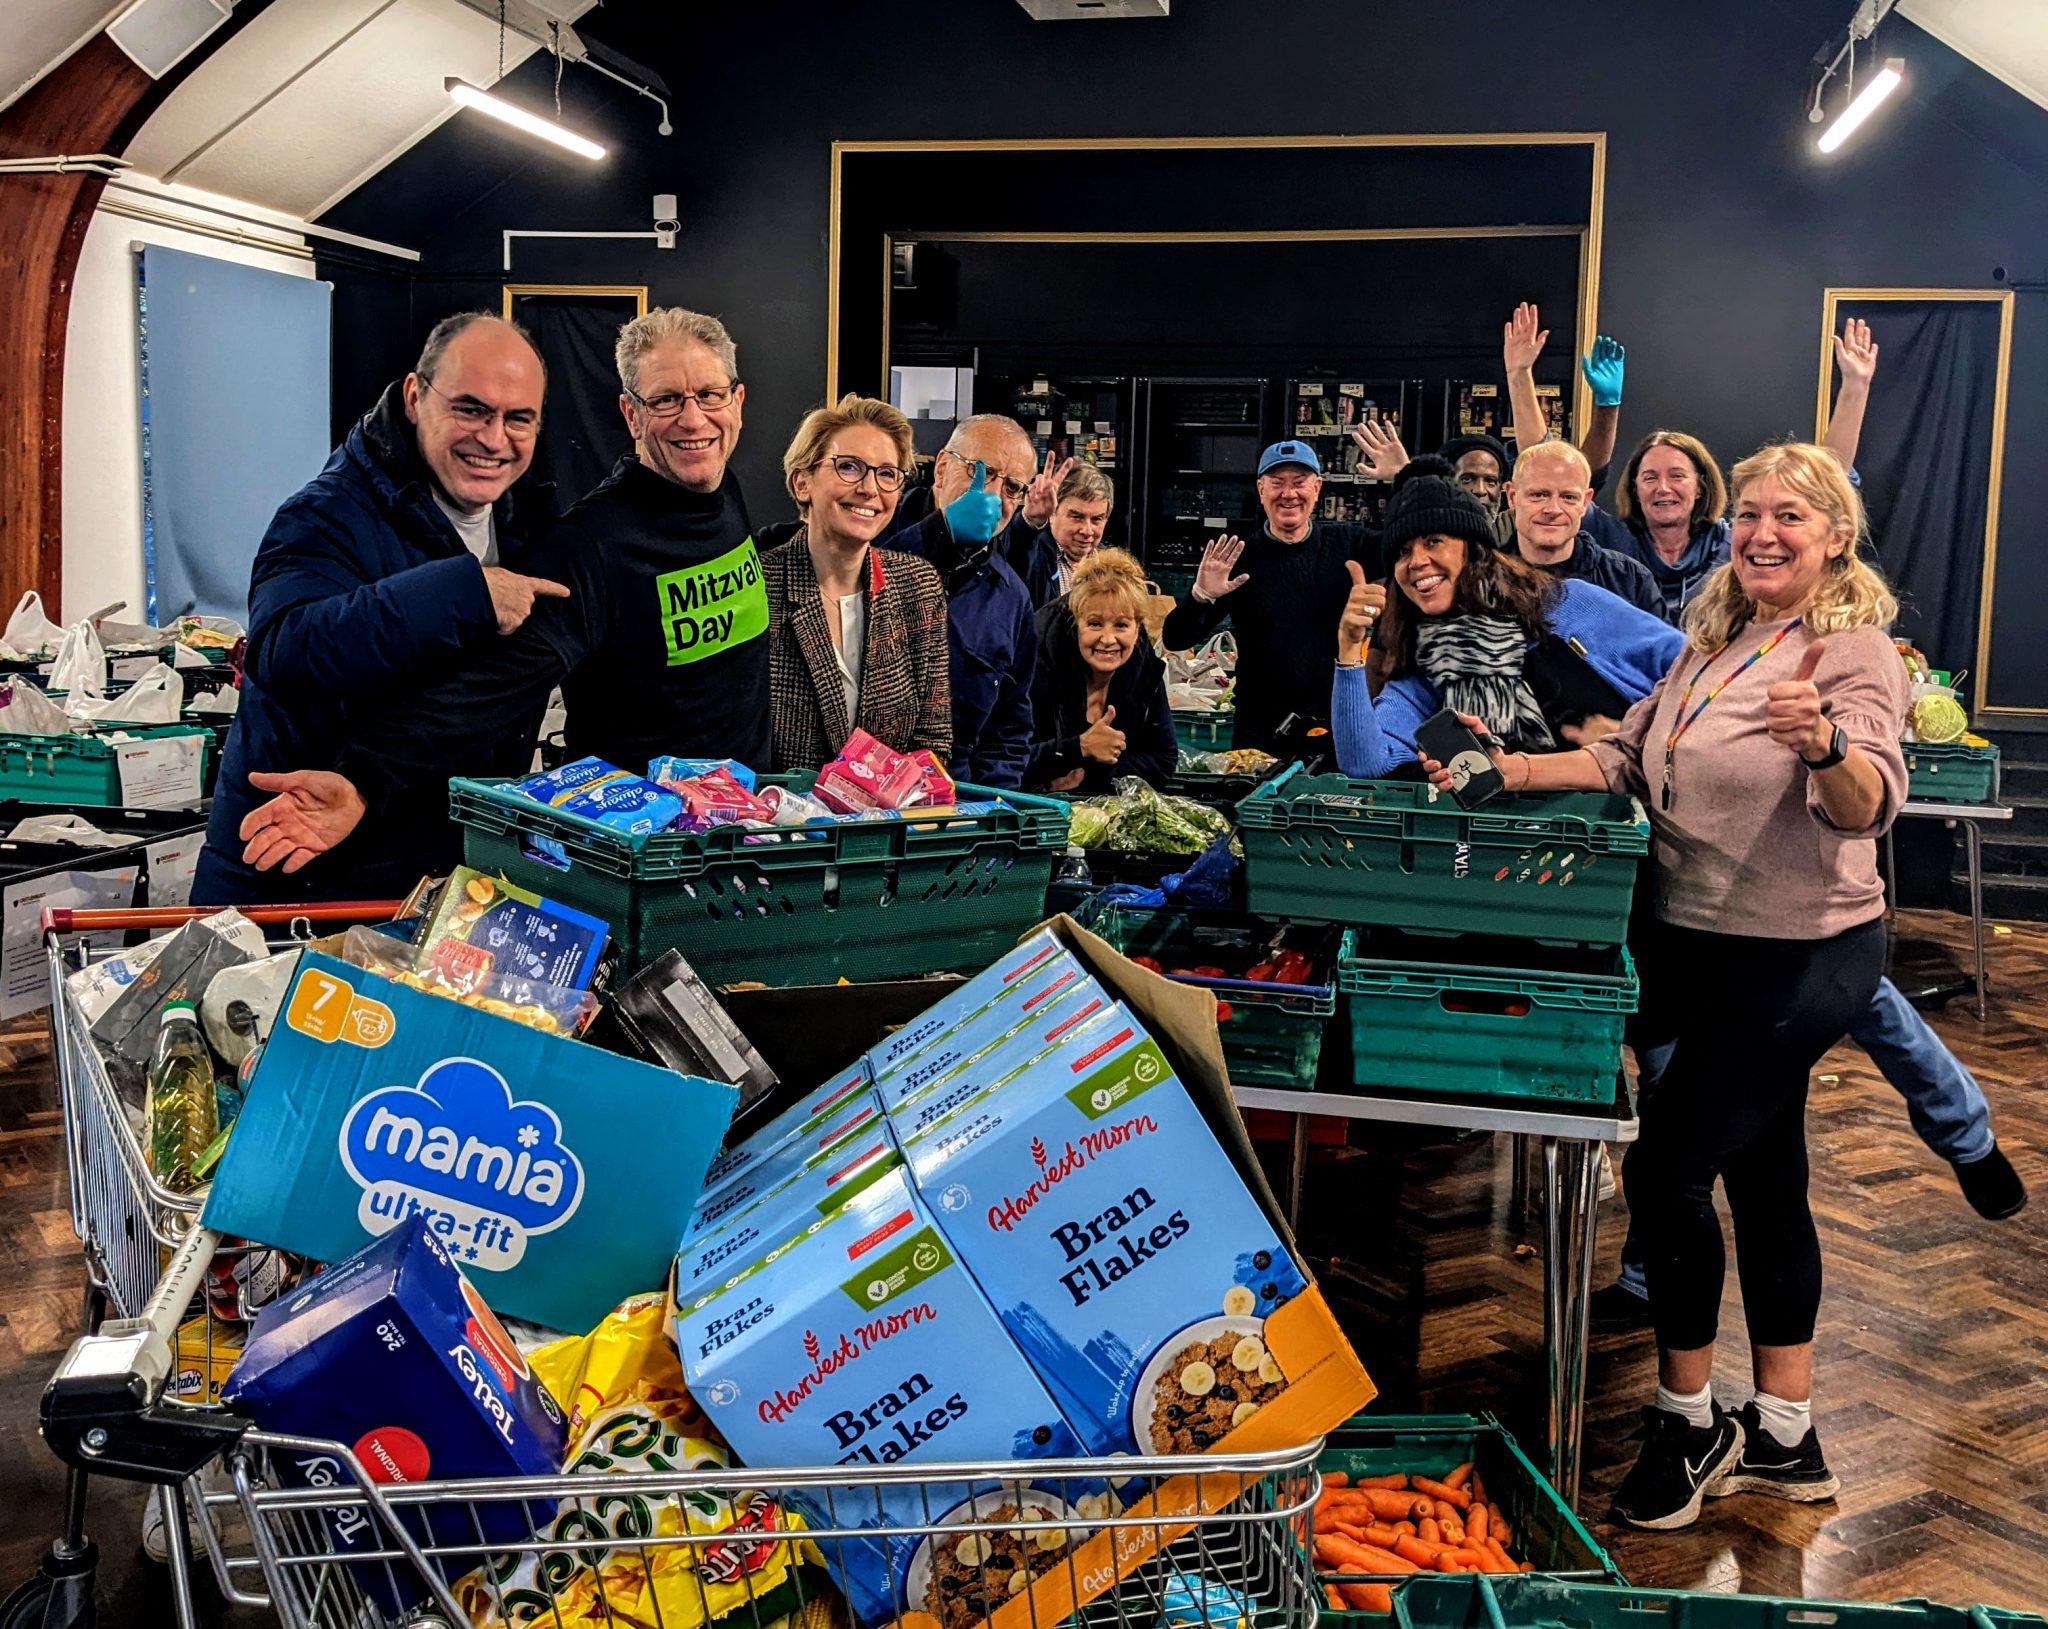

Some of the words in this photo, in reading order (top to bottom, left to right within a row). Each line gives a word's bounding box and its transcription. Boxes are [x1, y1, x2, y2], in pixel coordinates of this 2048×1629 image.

[667, 552, 763, 616] Mitzvah
[674, 610, 735, 651] Day
[552, 762, 601, 792] always
[593, 783, 644, 814] always
[313, 980, 337, 1011] 7
[362, 1023, 377, 1035] 22
[885, 1019, 945, 1062] Flakes
[890, 1018, 936, 1050] Bran
[898, 1050, 962, 1096] Flakes
[904, 1049, 952, 1084] Bran
[913, 1083, 981, 1131] Flakes
[919, 1082, 970, 1118] Bran
[935, 1112, 989, 1151] Bran
[365, 1106, 564, 1207] mamia
[988, 1143, 1085, 1231] Harvest
[1082, 1114, 1159, 1165] Morn
[370, 1191, 515, 1254] ultra-fit
[691, 1186, 756, 1232] Flakes
[699, 1185, 749, 1218] Bran
[1052, 1186, 1157, 1262] Bran
[690, 1229, 761, 1278] Flakes
[698, 1227, 751, 1263] Bran
[1060, 1209, 1190, 1305] Flakes
[375, 1323, 401, 1351] 240
[699, 1302, 776, 1361] Flakes
[705, 1297, 763, 1340] Bran
[469, 1330, 508, 1383] ORIGINAL
[759, 1338, 865, 1425] Harvest
[858, 1301, 937, 1355] Morn
[448, 1343, 516, 1446] Tetley
[823, 1373, 933, 1450] Bran
[295, 1456, 371, 1546] Teey
